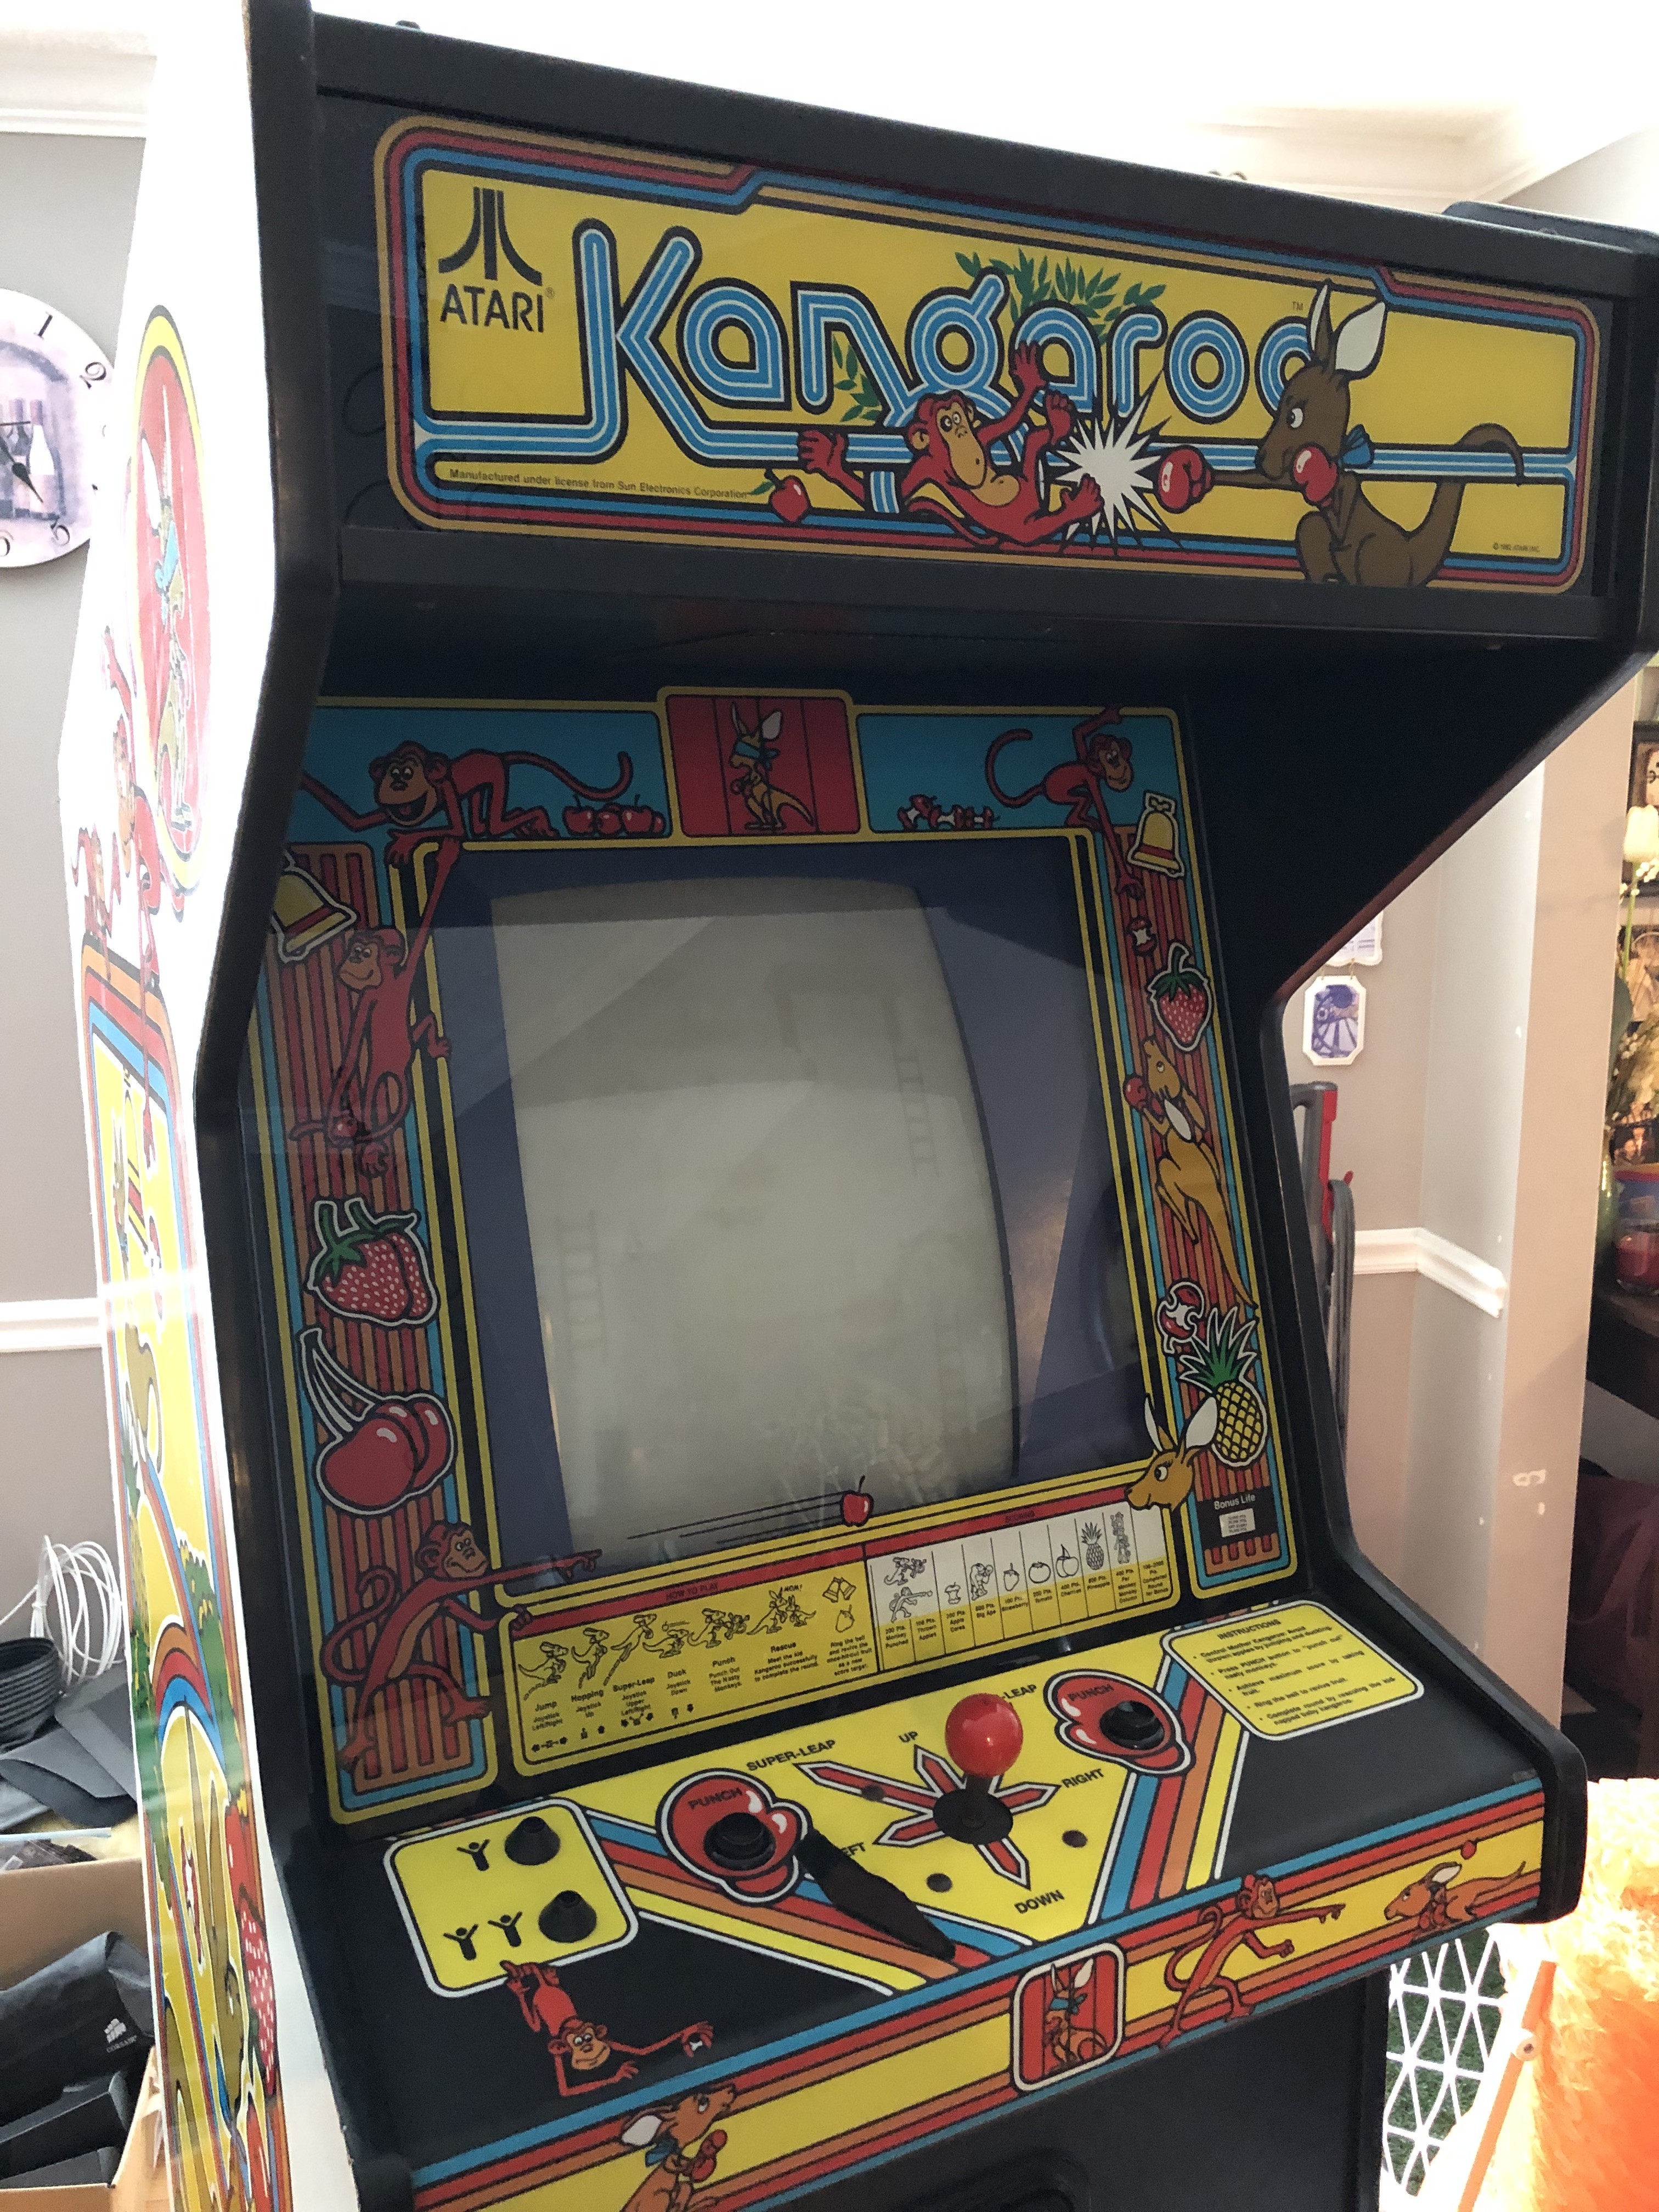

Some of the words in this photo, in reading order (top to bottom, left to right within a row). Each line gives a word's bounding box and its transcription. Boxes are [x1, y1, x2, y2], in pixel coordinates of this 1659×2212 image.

[440, 283, 544, 332] ATARI
[1293, 301, 1304, 311] TM
[572, 218, 1317, 466] Kangaroo
[80, 362, 106, 390] 2
[450, 469, 520, 483] Manufactured
[523, 476, 551, 486] under
[555, 476, 589, 488] license
[592, 479, 614, 489] from
[618, 481, 636, 490] Sun
[640, 482, 690, 495] Electronics
[694, 487, 747, 498] Corporation
[1214, 1498, 1239, 1510] Bonus
[1240, 1494, 1256, 1504] Life
[666, 1589, 684, 1600] HOW
[699, 1582, 718, 1592] PLAY
[886, 1632, 906, 1641] Monkey
[1217, 1619, 1282, 1640] INSTRUCTIONS
[771, 1642, 797, 1653] Rescue
[885, 1639, 909, 1649] Punched
[1200, 1647, 1227, 1657] Control
[1227, 1641, 1252, 1651] Mother
[1288, 1626, 1306, 1634] Avoid
[1206, 1654, 1232, 1663] thrown
[1232, 1647, 1255, 1657] apples
[1263, 1637, 1292, 1649] jumping
[712, 1657, 735, 1667] Punch
[754, 1664, 781, 1674] Kangaroo
[783, 1654, 817, 1668] successfully
[1240, 1657, 1265, 1667] PUNCH
[1267, 1651, 1290, 1660] button
[668, 1668, 686, 1679] Duck
[709, 1670, 727, 1679] Punch
[762, 1669, 788, 1680] complete
[1224, 1671, 1244, 1680] nasty
[1236, 1679, 1264, 1690] Achieve
[1269, 1669, 1302, 1681] maximum
[1306, 1662, 1325, 1671] score
[1342, 1650, 1365, 1659] taking
[613, 1677, 655, 1692] Super-Leap
[667, 1679, 691, 1689] Joystick
[1002, 1684, 1037, 1699] -LEAP
[1309, 1683, 1330, 1692] revive
[571, 1690, 603, 1702] Hopping
[622, 1690, 647, 1700] Joystick
[671, 1688, 687, 1696] Down
[1067, 1683, 1114, 1702] PUNCH
[535, 1701, 557, 1712] Jump
[576, 1701, 601, 1712] Joystick
[1267, 1706, 1301, 1719] Complete
[1304, 1699, 1324, 1708] round
[1338, 1686, 1369, 1698] rescuing
[534, 1712, 560, 1723] Joystick
[1274, 1715, 1300, 1725] napped
[899, 1731, 919, 1745] UP
[747, 1739, 836, 1772] SUPER-LEAP
[1061, 1769, 1105, 1790] RIGHT
[688, 1788, 743, 1811] PUNCH
[841, 1842, 866, 1857] EFT
[1014, 1890, 1065, 1915] DOWN
